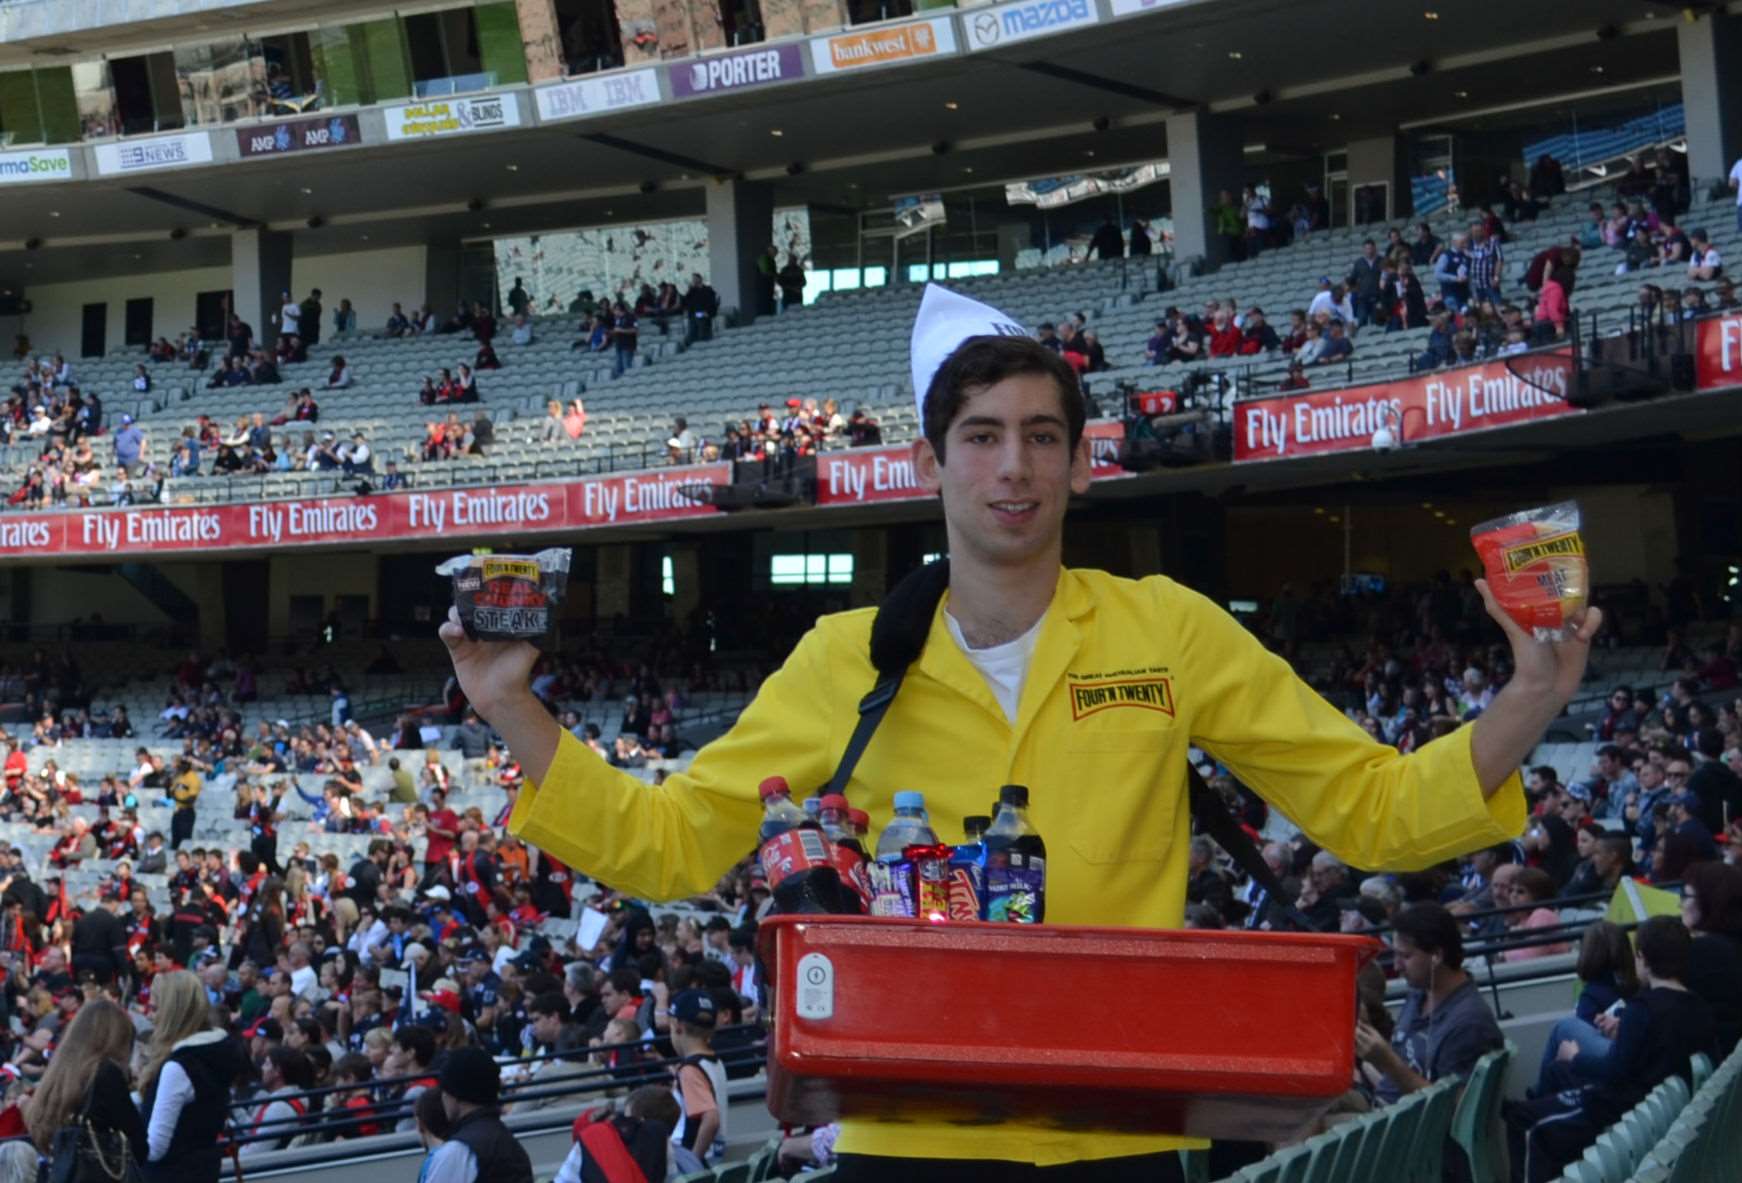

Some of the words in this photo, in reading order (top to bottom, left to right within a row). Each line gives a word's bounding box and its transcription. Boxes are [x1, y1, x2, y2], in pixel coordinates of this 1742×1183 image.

[1003, 0, 1089, 36] mazda
[834, 34, 908, 61] bankwest
[709, 50, 781, 89] PORTER
[471, 103, 504, 120] BLINDS
[546, 88, 587, 116] IBM
[602, 75, 645, 106] IBM
[143, 148, 185, 163] NEWS
[251, 135, 275, 152] AMP
[305, 129, 329, 146] AMP
[1426, 381, 1463, 430] Fly
[1468, 365, 1568, 417] Emirates
[1246, 408, 1288, 455] Fly
[1294, 397, 1401, 443] Emirates
[584, 482, 617, 522] Fly
[624, 473, 713, 513] Emirates
[829, 460, 867, 500] Fly
[250, 506, 283, 543] Fly
[289, 501, 378, 535] Emirates
[408, 495, 446, 533] Fly
[453, 488, 550, 526] Emirates
[0, 519, 50, 547] rates
[83, 514, 120, 549] Fly
[126, 510, 221, 544] Emirates
[1540, 534, 1581, 557] TWENTY
[1537, 568, 1567, 587] MEAT
[473, 608, 541, 633] STEAK
[1116, 682, 1166, 707] TWENTY
